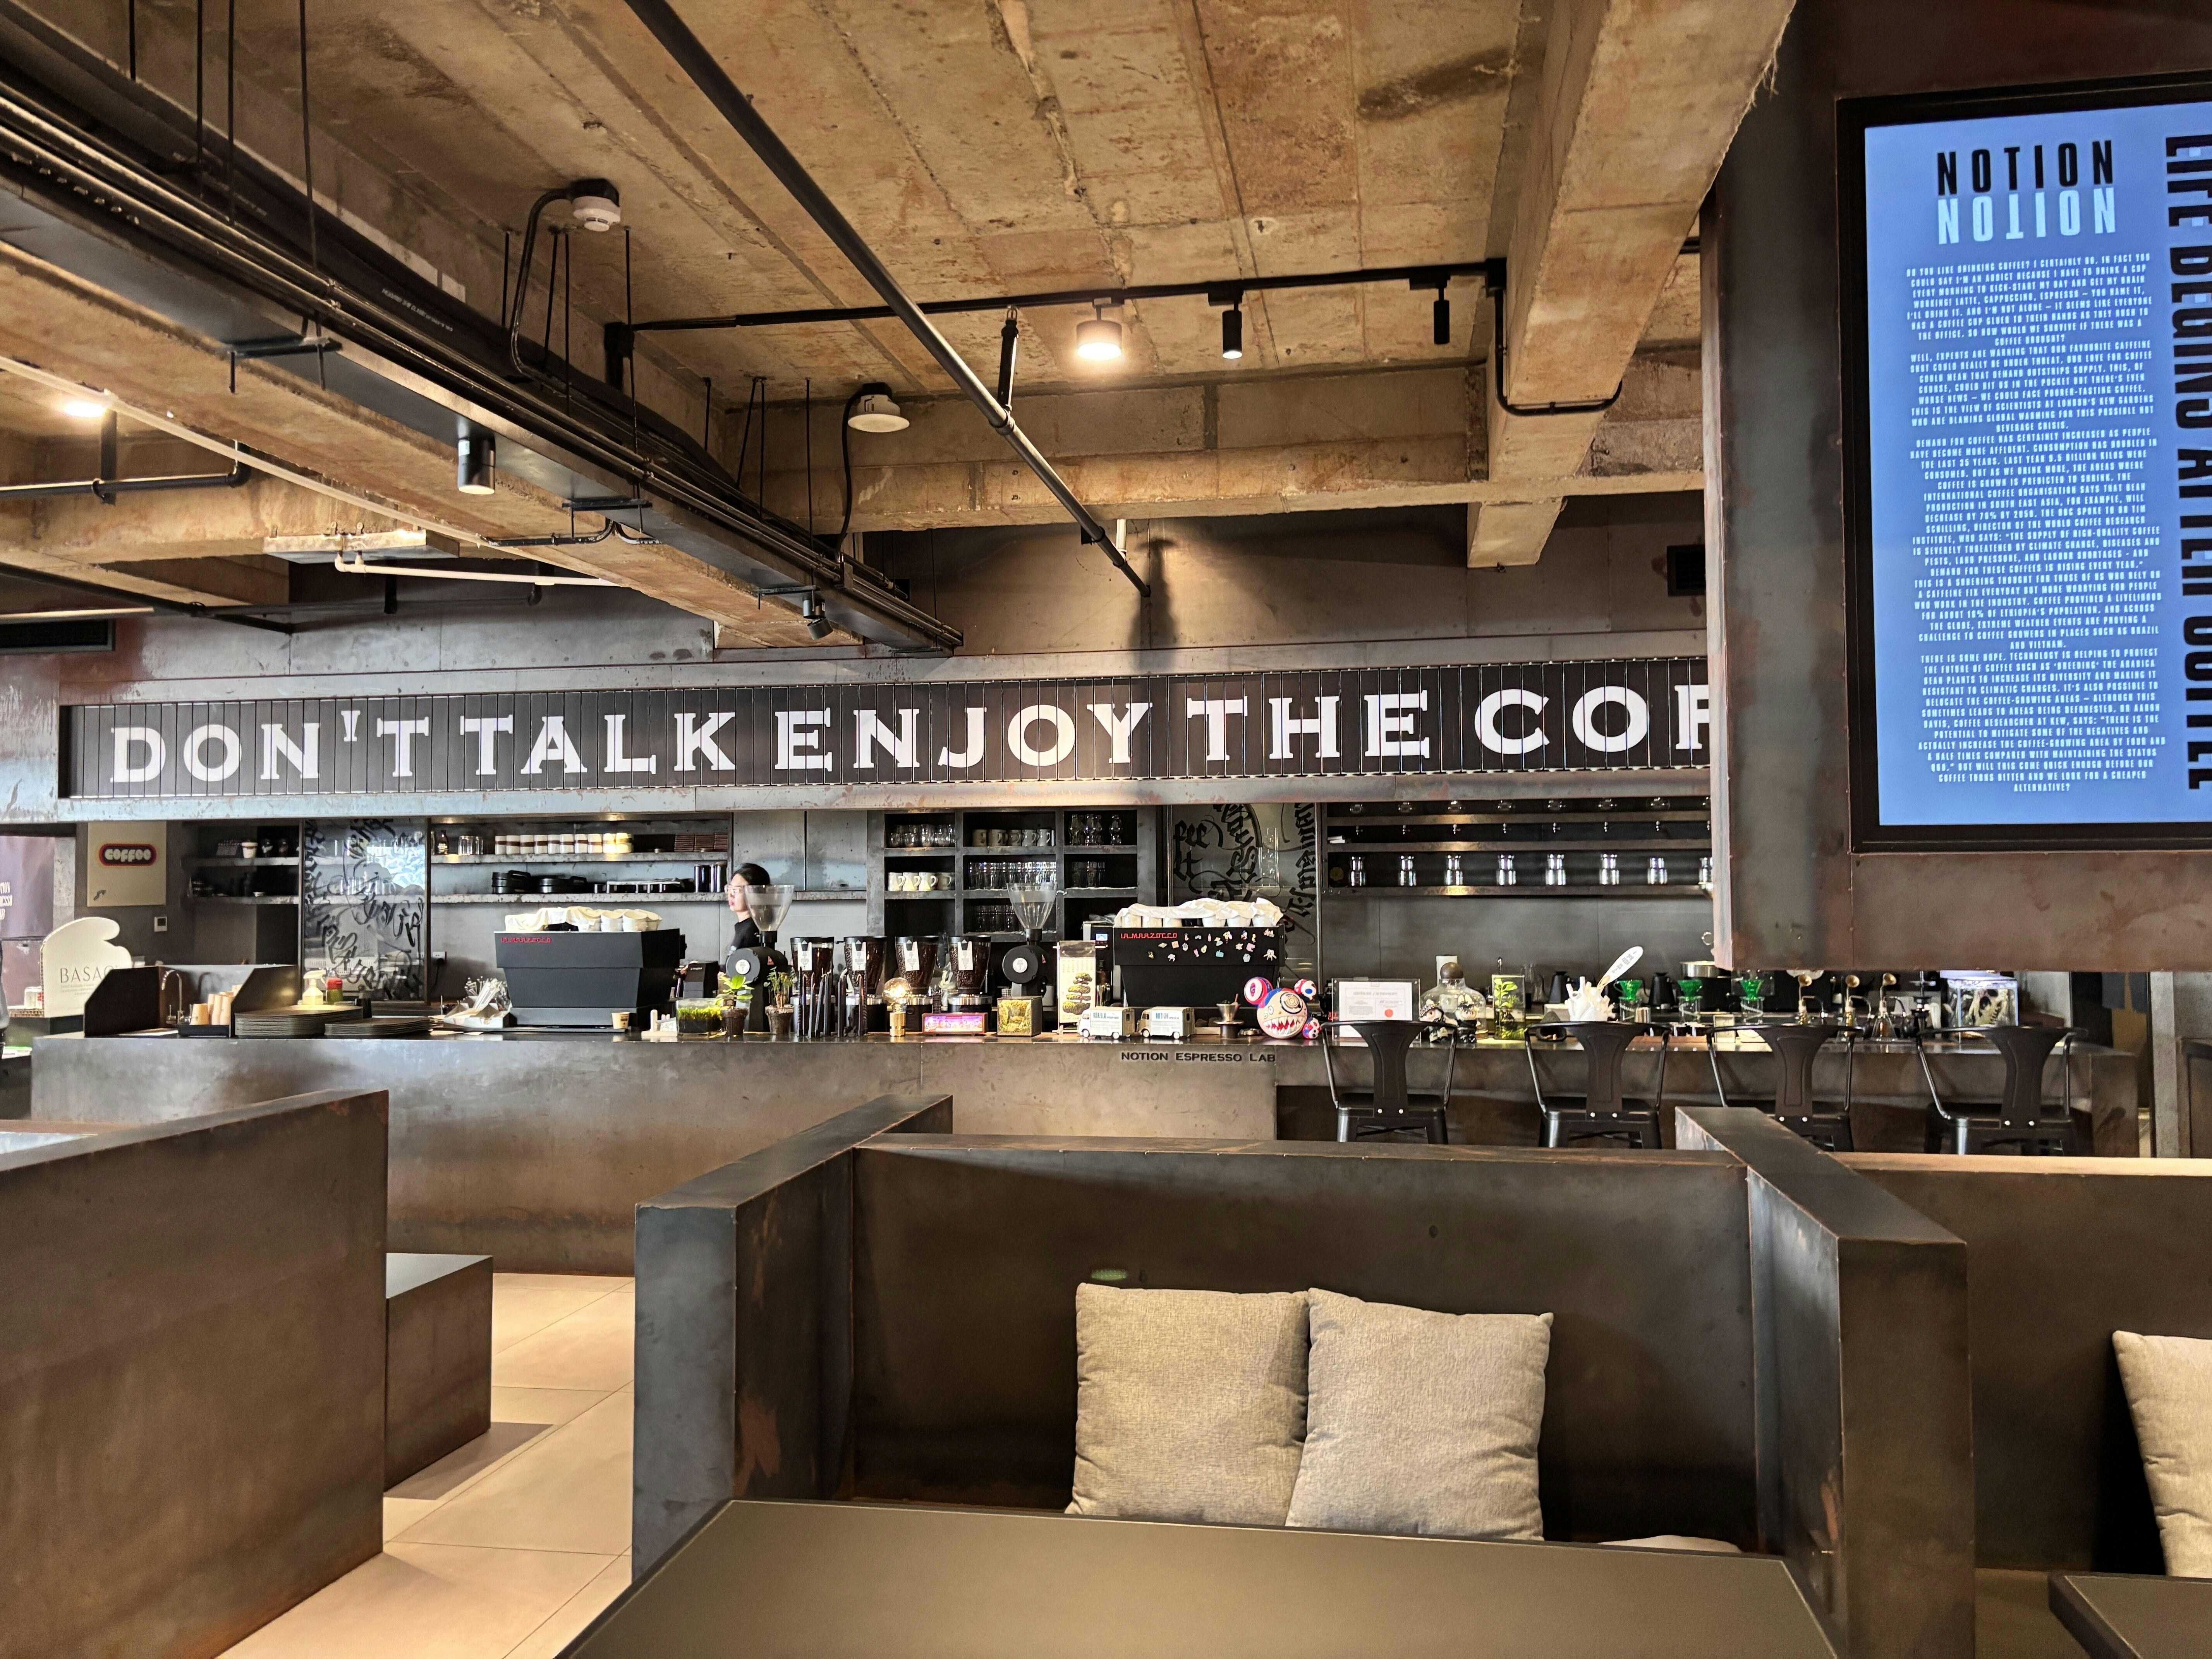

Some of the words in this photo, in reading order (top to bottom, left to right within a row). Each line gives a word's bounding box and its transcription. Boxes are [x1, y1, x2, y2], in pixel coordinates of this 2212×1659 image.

[1937, 140, 2113, 196] NOTION
[1906, 268, 1916, 277] DO
[1920, 267, 1934, 276] YOU
[1937, 266, 1954, 275] LIKE
[1957, 263, 1995, 273] DRINKING
[2033, 260, 2037, 268] I
[2040, 257, 2081, 268] CERTAINLY
[2102, 255, 2110, 264] IN
[2113, 254, 2132, 263] FACT
[2135, 253, 2150, 262] YOU
[1913, 288, 1935, 298] EVERY
[1939, 285, 1974, 296] MORNING
[1977, 285, 1986, 294] TO
[2039, 281, 2050, 290] MY
[2053, 280, 2068, 289] DAY
[2071, 278, 2087, 287] AND
[2090, 277, 2103, 286] GET
[2107, 276, 2117, 285] MY
[2121, 275, 2145, 285] BRAIN
[1918, 331, 1931, 340] THE
[1968, 328, 1978, 337] SO
[1981, 327, 1997, 336] HOW
[2001, 325, 2026, 335] WOULD
[2029, 325, 2040, 333] WE
[2044, 322, 2076, 333] SURVIVE
[2080, 321, 2087, 330] IF
[2091, 320, 2114, 330] THERE
[2117, 319, 2133, 328] WAS
[2137, 318, 2142, 327] A
[1936, 350, 1968, 361] EXPERTS
[1972, 349, 1986, 358] ARE
[1990, 347, 2025, 357] WARNING
[2029, 345, 2047, 355] THAT
[2051, 344, 2066, 354] OUR
[2069, 342, 2111, 353] FAVOURITE
[2114, 340, 2150, 350] CAFFEINE
[1911, 417, 1928, 427] WHO
[1931, 416, 1945, 426] ARE
[1949, 414, 1983, 424] BLAMING
[1986, 412, 2015, 422] GLOBAL
[2018, 410, 2055, 421] WARMING
[2058, 409, 2073, 418] FOR
[2076, 408, 2095, 417] THIS
[2098, 406, 2136, 416] POSSIBLE
[2139, 405, 2154, 414] HOT
[1921, 460, 1934, 469] THE
[1938, 459, 1956, 468] LAST
[2004, 455, 2023, 465] LAST
[2026, 454, 2045, 464] YEAR
[2066, 452, 2097, 462] BILLION
[2100, 450, 2124, 460] KILOS
[2126, 449, 2147, 459] WERE
[1924, 490, 1984, 501] INTERNATIONAL
[1987, 488, 2014, 498] COFFEE
[2018, 486, 2076, 497] ORGANISATION
[2080, 484, 2100, 494] SAYS
[2103, 483, 2122, 493] THAT
[2126, 483, 2145, 492] BEAN
[1973, 521, 2011, 531] DIRECTOR
[2015, 520, 2024, 529] OF
[2028, 520, 2041, 529] THE
[2045, 519, 2071, 528] WORLD
[2074, 517, 2102, 527] COFFEE
[2106, 515, 2145, 526] RESEARCH
[1913, 547, 1921, 556] IS
[1925, 545, 1961, 555] SEVERELY
[1965, 543, 2012, 553] THREATENED
[2015, 543, 2026, 551] BY
[2029, 541, 2062, 551] CLIMATE
[2102, 538, 2141, 548] DISEASES
[2144, 537, 2160, 546] AND
[1918, 590, 1922, 599] A
[1926, 589, 1962, 598] CAFFEINE
[1965, 588, 1978, 597] FIX
[1982, 587, 2020, 596] EVERYDAY
[2023, 586, 2038, 594] BUT
[2042, 585, 2063, 594] MORE
[2066, 583, 2107, 593] WORRYING
[2111, 582, 2126, 591] FOR
[2128, 581, 2157, 591] PEOPLE
[1918, 632, 1961, 642] CHALLENGE
[1964, 632, 1973, 640] TO
[1977, 630, 2004, 640] COFFEE
[2008, 629, 2044, 639] GROWERS
[2048, 629, 2056, 637] IN
[2060, 628, 2089, 637] PLACES
[2093, 627, 2114, 636] SUCH
[2117, 627, 2127, 635] AS
[2131, 626, 2159, 635] BRAZIL
[1923, 676, 1943, 685] BEAN
[1946, 675, 1975, 685] PLANTS
[1978, 675, 1988, 684] TO
[1991, 673, 2030, 683] INCREASE
[2033, 673, 2046, 682] ITS
[2050, 672, 2091, 682] DIVERSITY
[2095, 672, 2111, 680] AND
[2114, 670, 2145, 679] MAKING
[2148, 670, 2156, 678] IT
[110, 710, 429, 783] DON'T
[460, 712, 736, 775] TALK
[775, 702, 1153, 772] ENJOY
[1187, 690, 1430, 761] THE
[1934, 730, 1975, 739] POTENTIAL
[1978, 729, 1988, 738] TO
[1991, 728, 2028, 738] MITIGATE
[2032, 728, 2053, 737] SOME
[2056, 728, 2066, 736] OF
[2069, 727, 2083, 736] THE
[2086, 726, 2130, 735] NEGATIVES
[2133, 726, 2148, 734] AND
[1927, 752, 1932, 761] A
[1936, 752, 1954, 761] HALF
[1957, 752, 1980, 760] TIMES
[1984, 750, 2025, 760] COMPARED
[2029, 750, 2049, 759] WITH
[2052, 749, 2106, 758] MAINTAINING
[2109, 749, 2123, 757] THE
[2127, 748, 2157, 757] STATUS
[1121, 1052, 1168, 1061] NOTION
[1176, 1053, 1242, 1062] ESPRESSO
[1250, 1054, 1275, 1062] LAB
